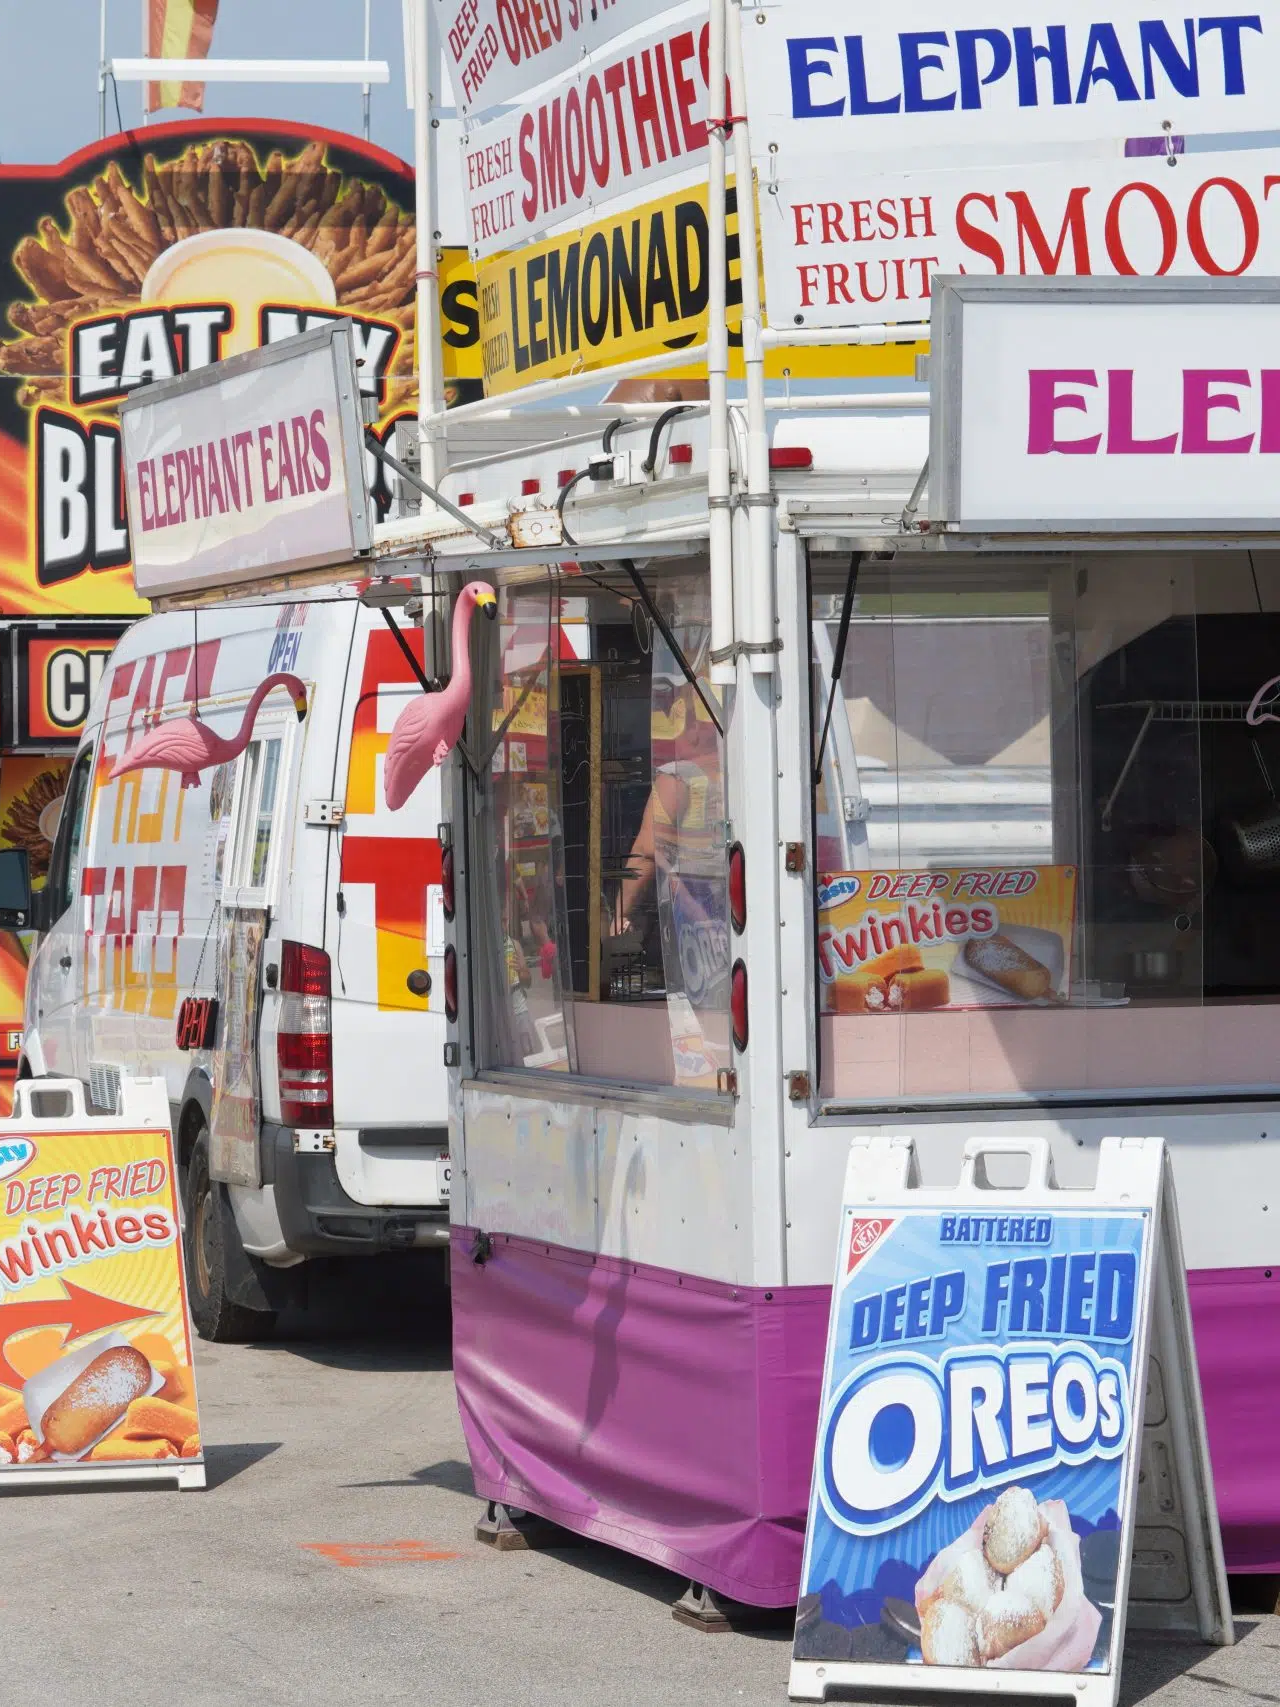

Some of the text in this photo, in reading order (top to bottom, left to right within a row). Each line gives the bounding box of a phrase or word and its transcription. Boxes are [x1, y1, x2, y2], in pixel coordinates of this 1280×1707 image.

[461, 23, 499, 104] FRIED
[786, 15, 1262, 119] ELEPHANT
[519, 20, 733, 223] SMOOTHIES
[467, 137, 513, 190] FRESH
[471, 190, 516, 244] FRUIT
[793, 196, 936, 246] FRESH
[955, 174, 1280, 276] SMOO
[481, 278, 500, 326] FRESH
[509, 186, 745, 375] LEMONADE
[796, 256, 939, 307] FRUIT
[77, 309, 226, 397] EAT
[136, 431, 254, 533] ELEPHANT
[260, 408, 333, 502] EARS
[267, 632, 303, 674] OPEN
[867, 870, 1039, 899] DEEP FRIED
[818, 902, 994, 978] Twinkies
[175, 998, 217, 1049] OPEN
[5, 1158, 166, 1215] DEEP FRIED
[854, 1224, 882, 1248] NEAT
[939, 1214, 1052, 1244] BATTERED
[850, 1251, 1138, 1351] DEEP FRIED
